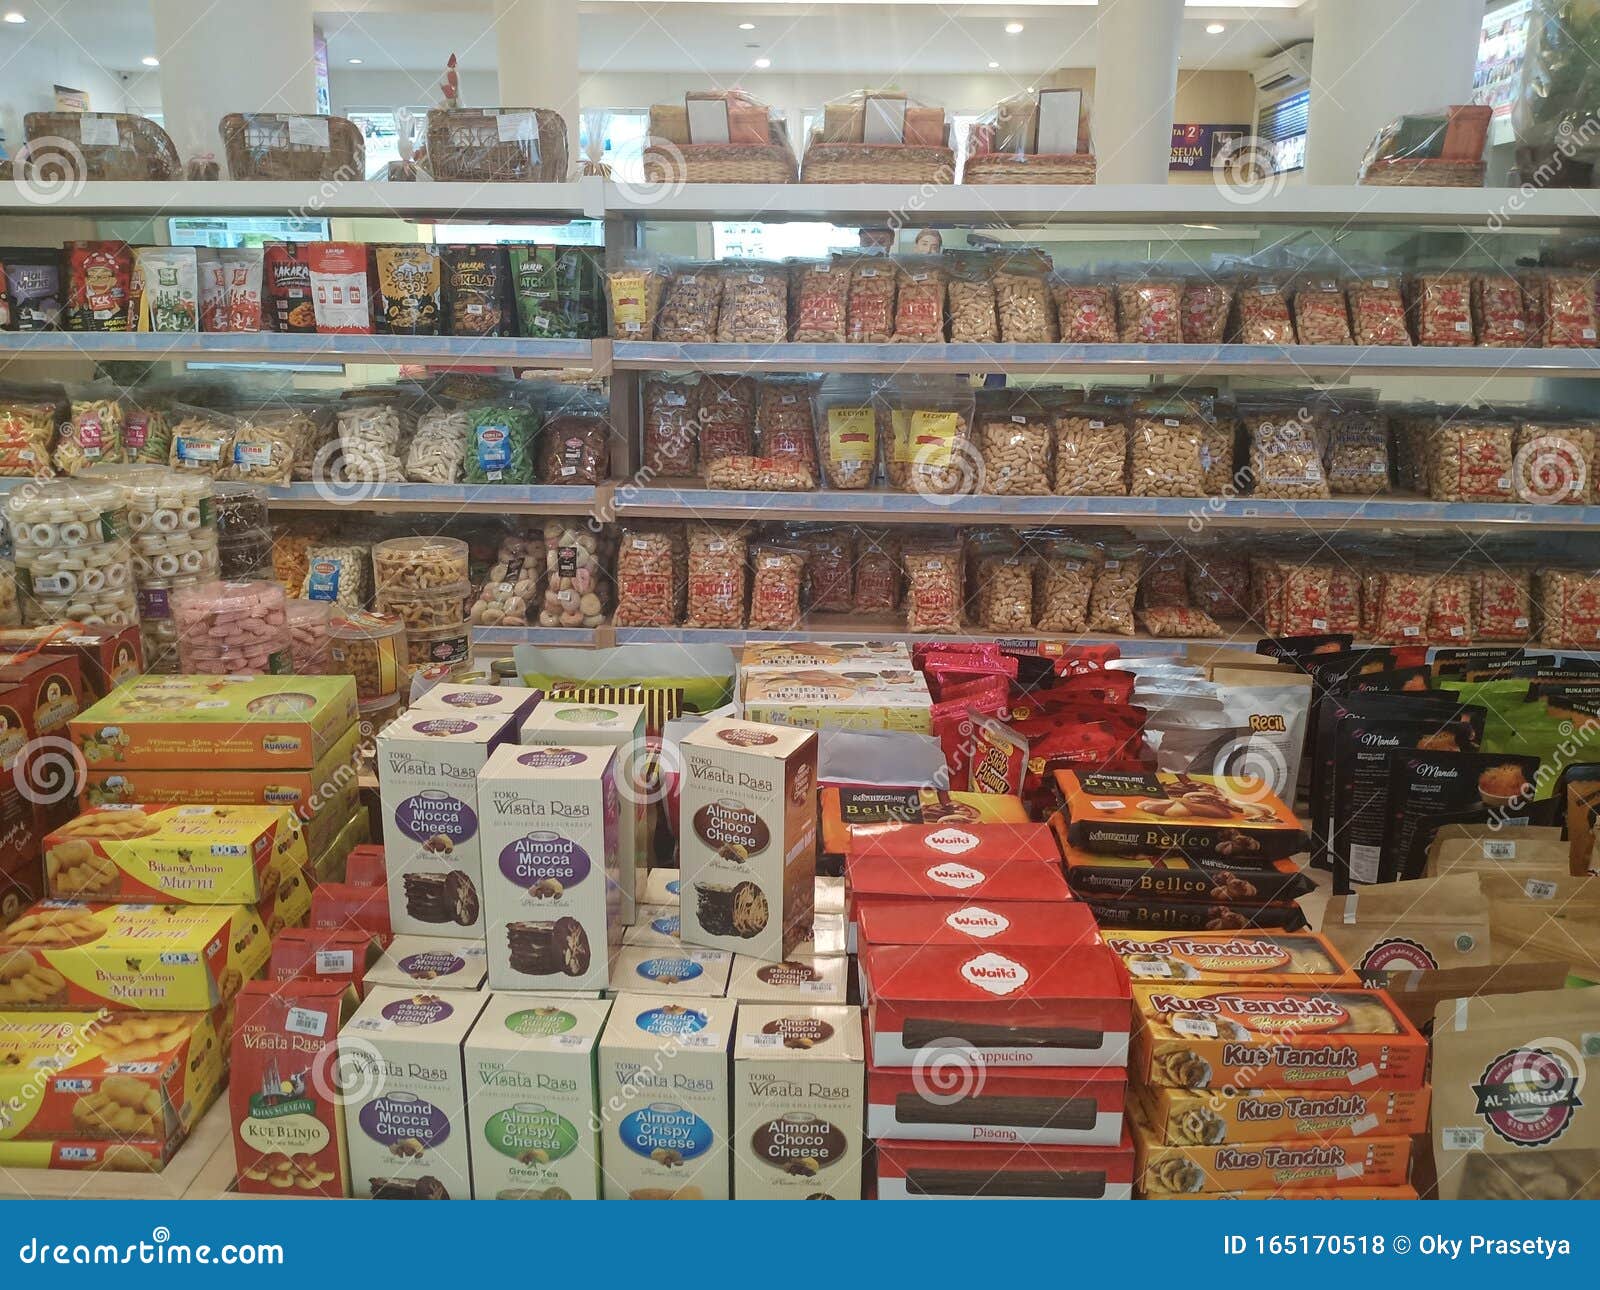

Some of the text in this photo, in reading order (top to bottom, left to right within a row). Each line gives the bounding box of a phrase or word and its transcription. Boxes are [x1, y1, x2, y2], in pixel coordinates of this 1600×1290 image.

[1187, 126, 1196, 138] 2
[273, 265, 310, 279] KAKARA
[1249, 714, 1286, 732] Recil
[1361, 733, 1400, 746] Manda
[690, 755, 712, 766] TOKO
[389, 760, 476, 780] Wisata Rasa
[1416, 763, 1457, 778] Manda
[690, 764, 773, 793] Wisata Rasa
[1084, 778, 1158, 793] Bellco
[493, 791, 519, 799] TOKO
[409, 798, 463, 812] Almond
[493, 800, 590, 818] Wisata Rasa
[413, 809, 459, 823] Mocca
[706, 805, 758, 825] Almond
[410, 820, 463, 834] Cheese
[710, 817, 752, 835] Choco
[706, 829, 756, 847] Cheese
[931, 836, 970, 846] Waiki
[1145, 832, 1210, 847] Bellco
[514, 840, 573, 853] Almond
[518, 852, 570, 866] Mocca
[148, 860, 224, 875] Bikang Ambon
[515, 864, 574, 878] Cheese
[934, 869, 976, 880] Waiki
[1139, 875, 1206, 891] Bellco
[954, 916, 999, 927] Waiki
[1136, 907, 1201, 922] Bellco
[1109, 938, 1285, 957] Kue Tanduk
[95, 968, 136, 984] Bikang
[969, 965, 1017, 980] Waiki
[1151, 994, 1343, 1017] Kue Tanduk
[244, 1025, 266, 1033] TOKO
[775, 1018, 822, 1027] Almond
[782, 1031, 822, 1039] Cheese
[243, 1033, 327, 1053] Wisata Rasa
[969, 1051, 1033, 1064] Cappucino
[1223, 1044, 1358, 1068] Kue Tanduk
[351, 1059, 449, 1082] Wisata Rasa
[479, 1062, 504, 1070] TOKO
[615, 1062, 641, 1071] TOKO
[479, 1070, 578, 1093] Wisata Rasa
[615, 1070, 715, 1093] Wisata Rasa
[749, 1073, 776, 1081] TOKO
[748, 1080, 850, 1100] Wisata Rasa
[374, 1101, 432, 1116] Almond
[1237, 1096, 1367, 1122] Kue Tanduk
[379, 1112, 430, 1127] Mocca
[501, 1111, 561, 1126] Almond
[635, 1111, 697, 1126] Almond
[249, 1124, 321, 1141] KUE BLINJO
[376, 1123, 434, 1139] Cheese
[505, 1123, 557, 1139] Crispy
[640, 1123, 692, 1140] Crispy
[768, 1121, 831, 1134] Almond
[971, 1126, 1018, 1141] Pisang
[502, 1135, 561, 1150] Cheese
[636, 1135, 696, 1150] Cheese
[773, 1133, 824, 1146] Choco
[768, 1145, 830, 1158] Cheese
[1215, 1147, 1346, 1170] Kue Tanduk
[508, 1167, 559, 1178] Green Tea
